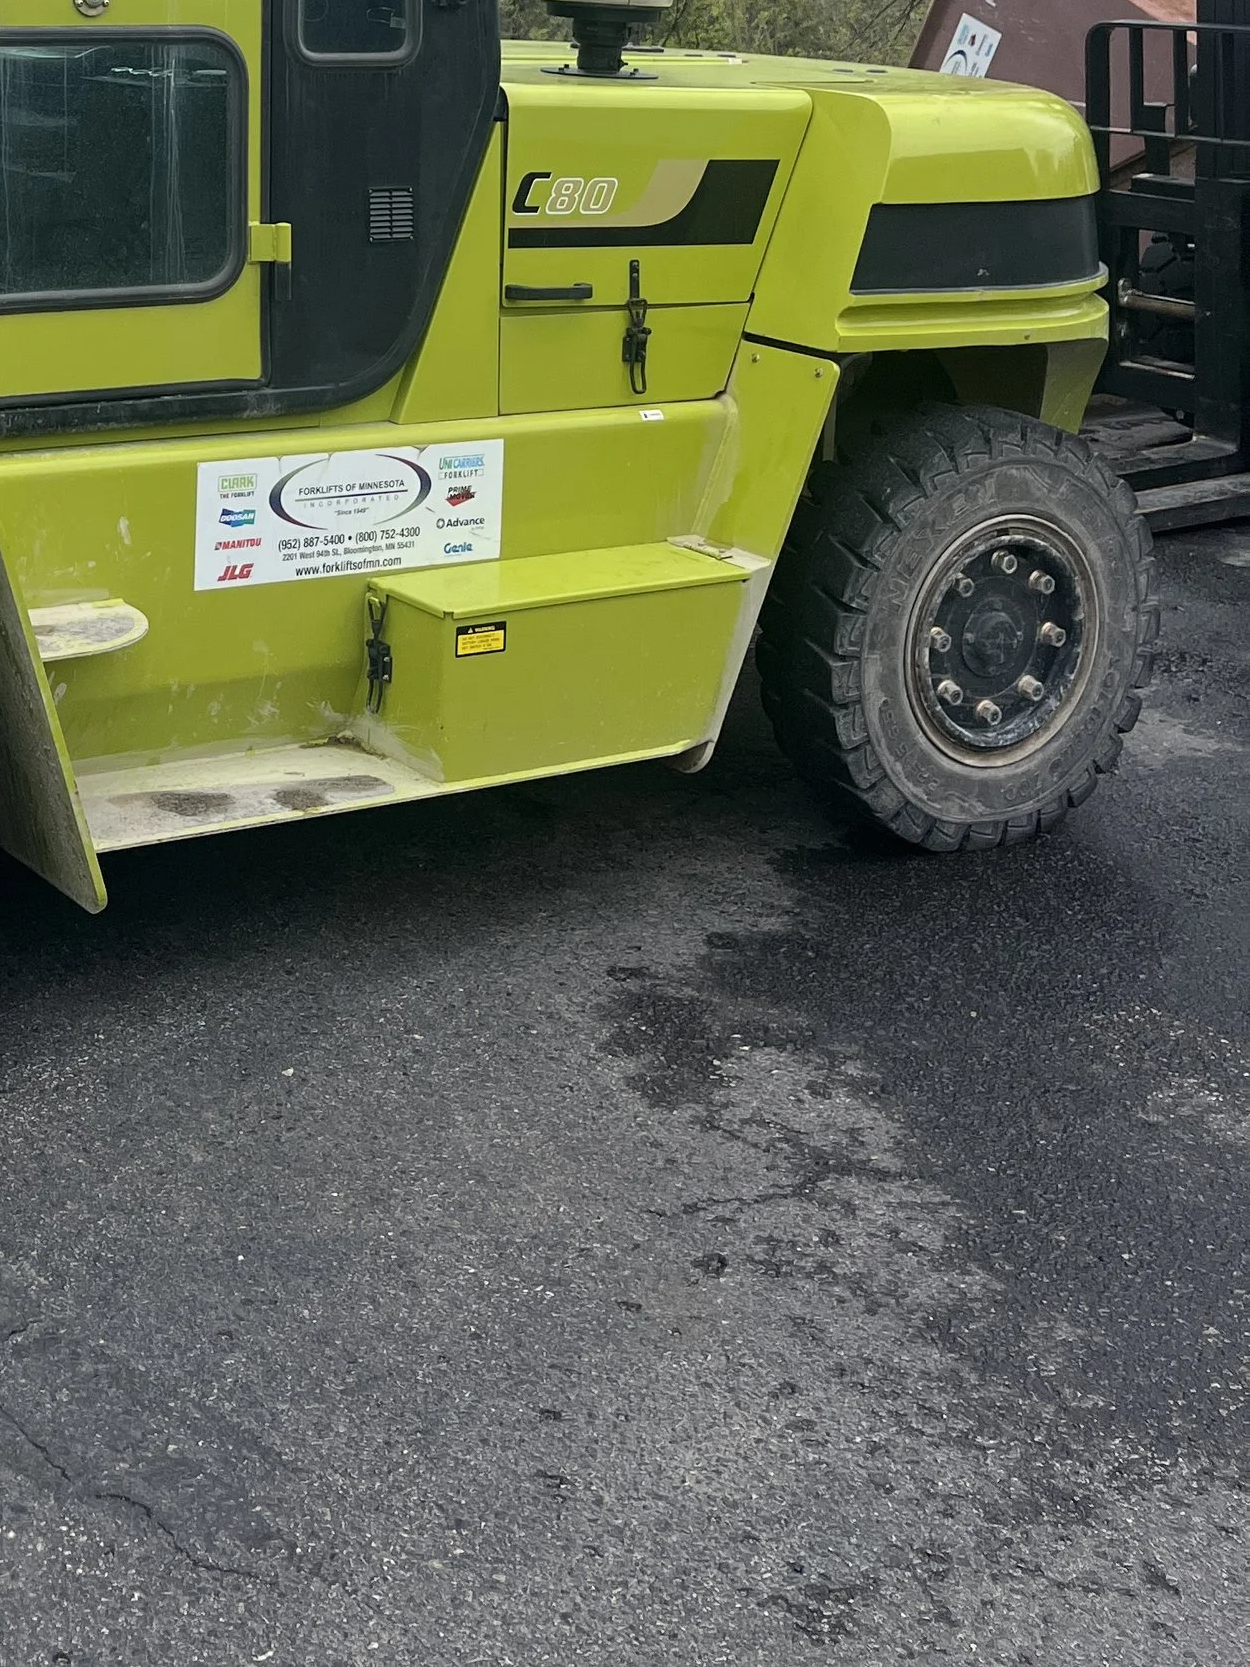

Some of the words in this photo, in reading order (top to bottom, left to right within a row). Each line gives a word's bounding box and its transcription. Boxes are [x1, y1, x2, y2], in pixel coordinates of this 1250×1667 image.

[511, 171, 618, 215] C80
[444, 469, 479, 479] FORKLIFT
[221, 474, 254, 490] CLARK
[299, 485, 343, 496] FORKLIFTS
[345, 483, 356, 492] OF
[359, 479, 405, 491] MINNESOTA
[448, 485, 472, 493] PRIME
[304, 494, 399, 508] INCORPORATED
[220, 512, 254, 523] DOOSAN
[446, 517, 485, 528] Advance
[222, 538, 262, 550] MANITOU
[278, 539, 301, 552] (952)
[303, 534, 345, 548] 887-5400
[355, 530, 377, 544] (800)
[380, 526, 420, 540] 752-4300
[282, 553, 297, 562] 2201
[299, 551, 315, 559] West
[316, 550, 331, 558] 94th
[343, 544, 384, 555] Bloomington,
[385, 542, 396, 551] MN
[397, 540, 415, 550] 55431
[444, 542, 473, 554] Genie
[217, 563, 254, 582] JLG
[295, 556, 402, 576] www.forkliftsofmn.com
